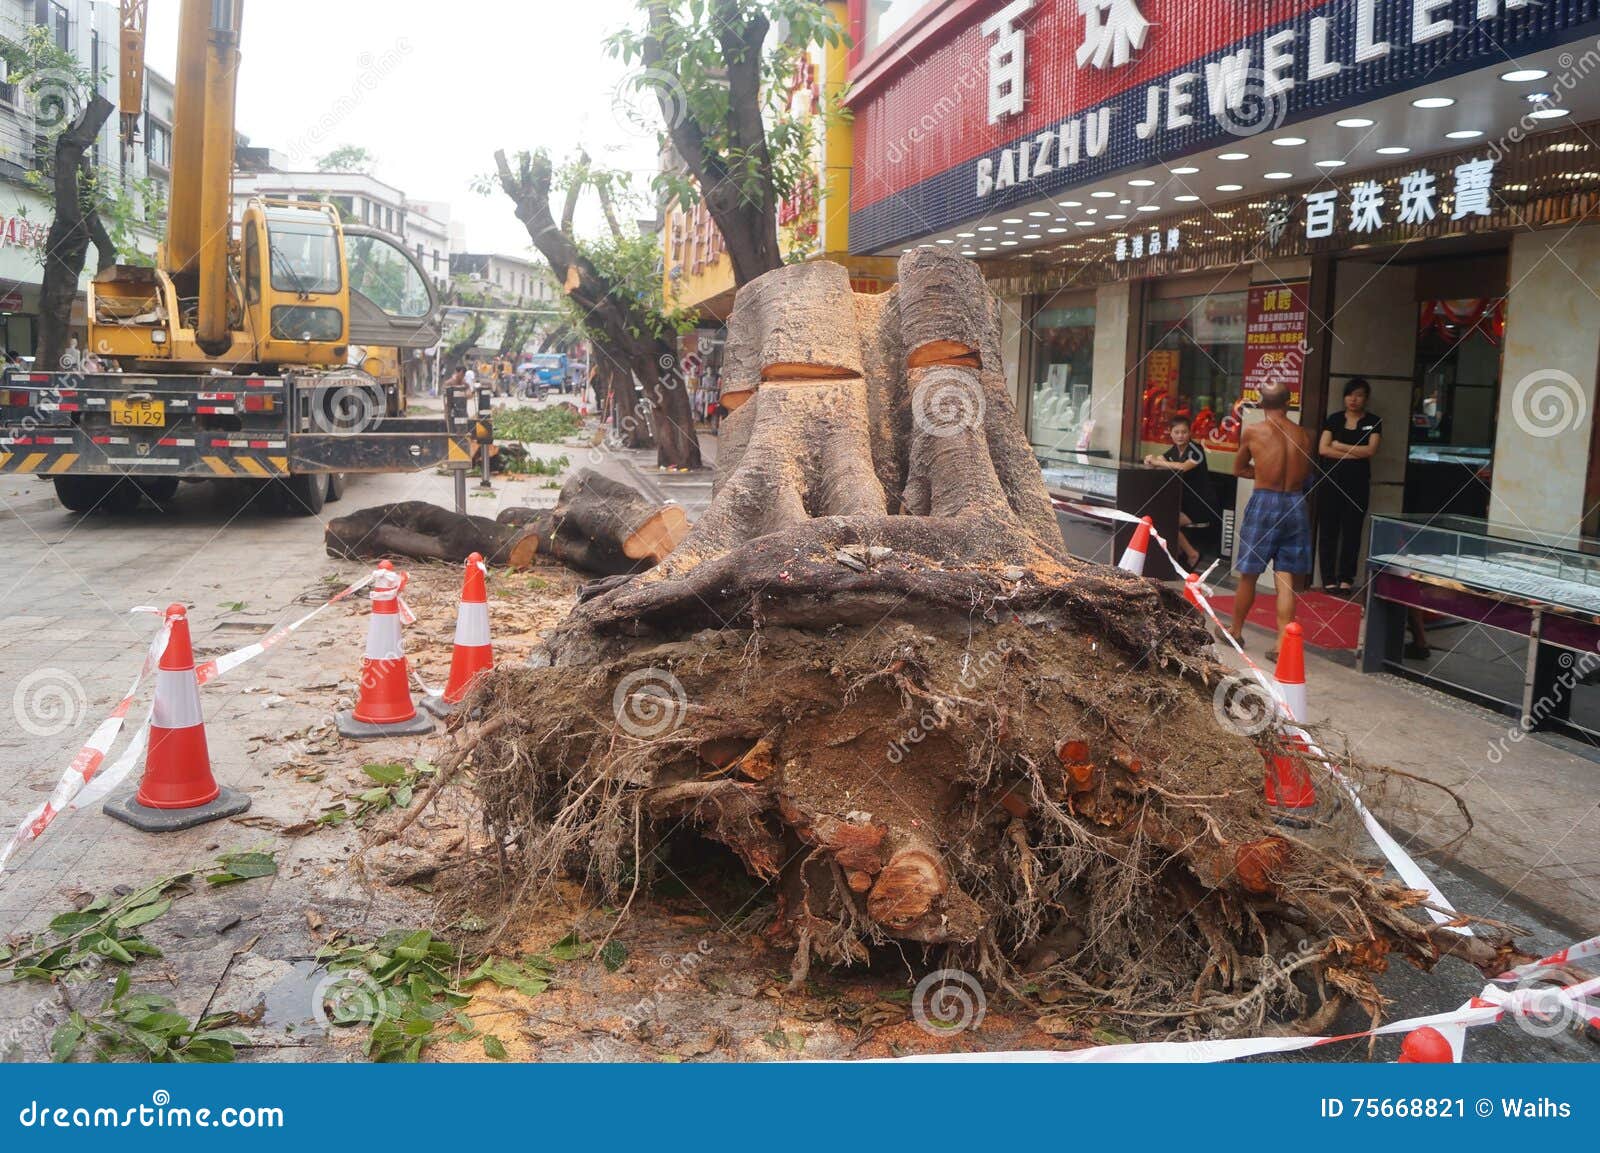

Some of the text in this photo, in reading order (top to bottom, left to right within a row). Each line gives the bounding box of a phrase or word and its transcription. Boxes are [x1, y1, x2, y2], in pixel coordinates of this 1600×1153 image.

[976, 107, 1111, 198] BAIZHU
[1306, 157, 1494, 239] 百珠珠寶
[113, 410, 162, 425] L5129
